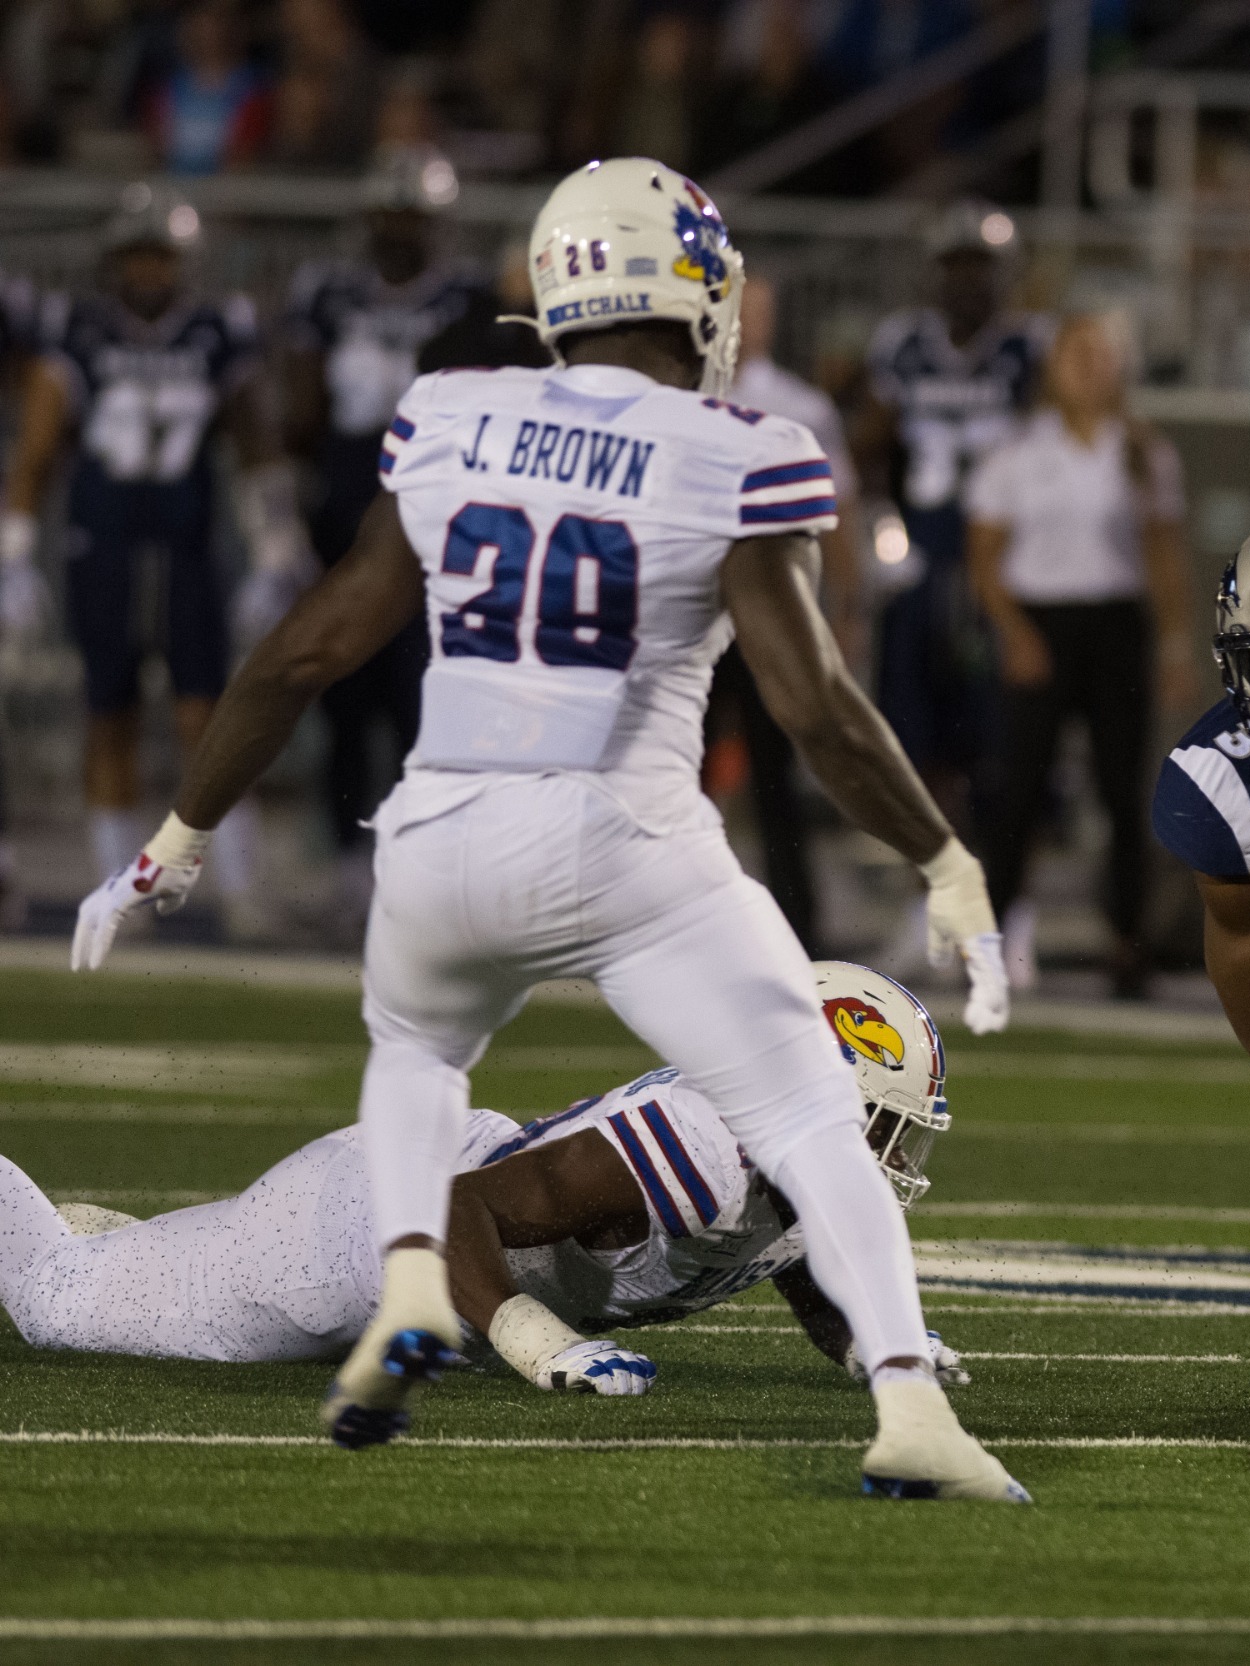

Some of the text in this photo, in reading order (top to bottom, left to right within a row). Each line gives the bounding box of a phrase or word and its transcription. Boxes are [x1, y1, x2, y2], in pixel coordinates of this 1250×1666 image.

[587, 293, 652, 315] CHALK
[461, 414, 655, 498] J. BROWN
